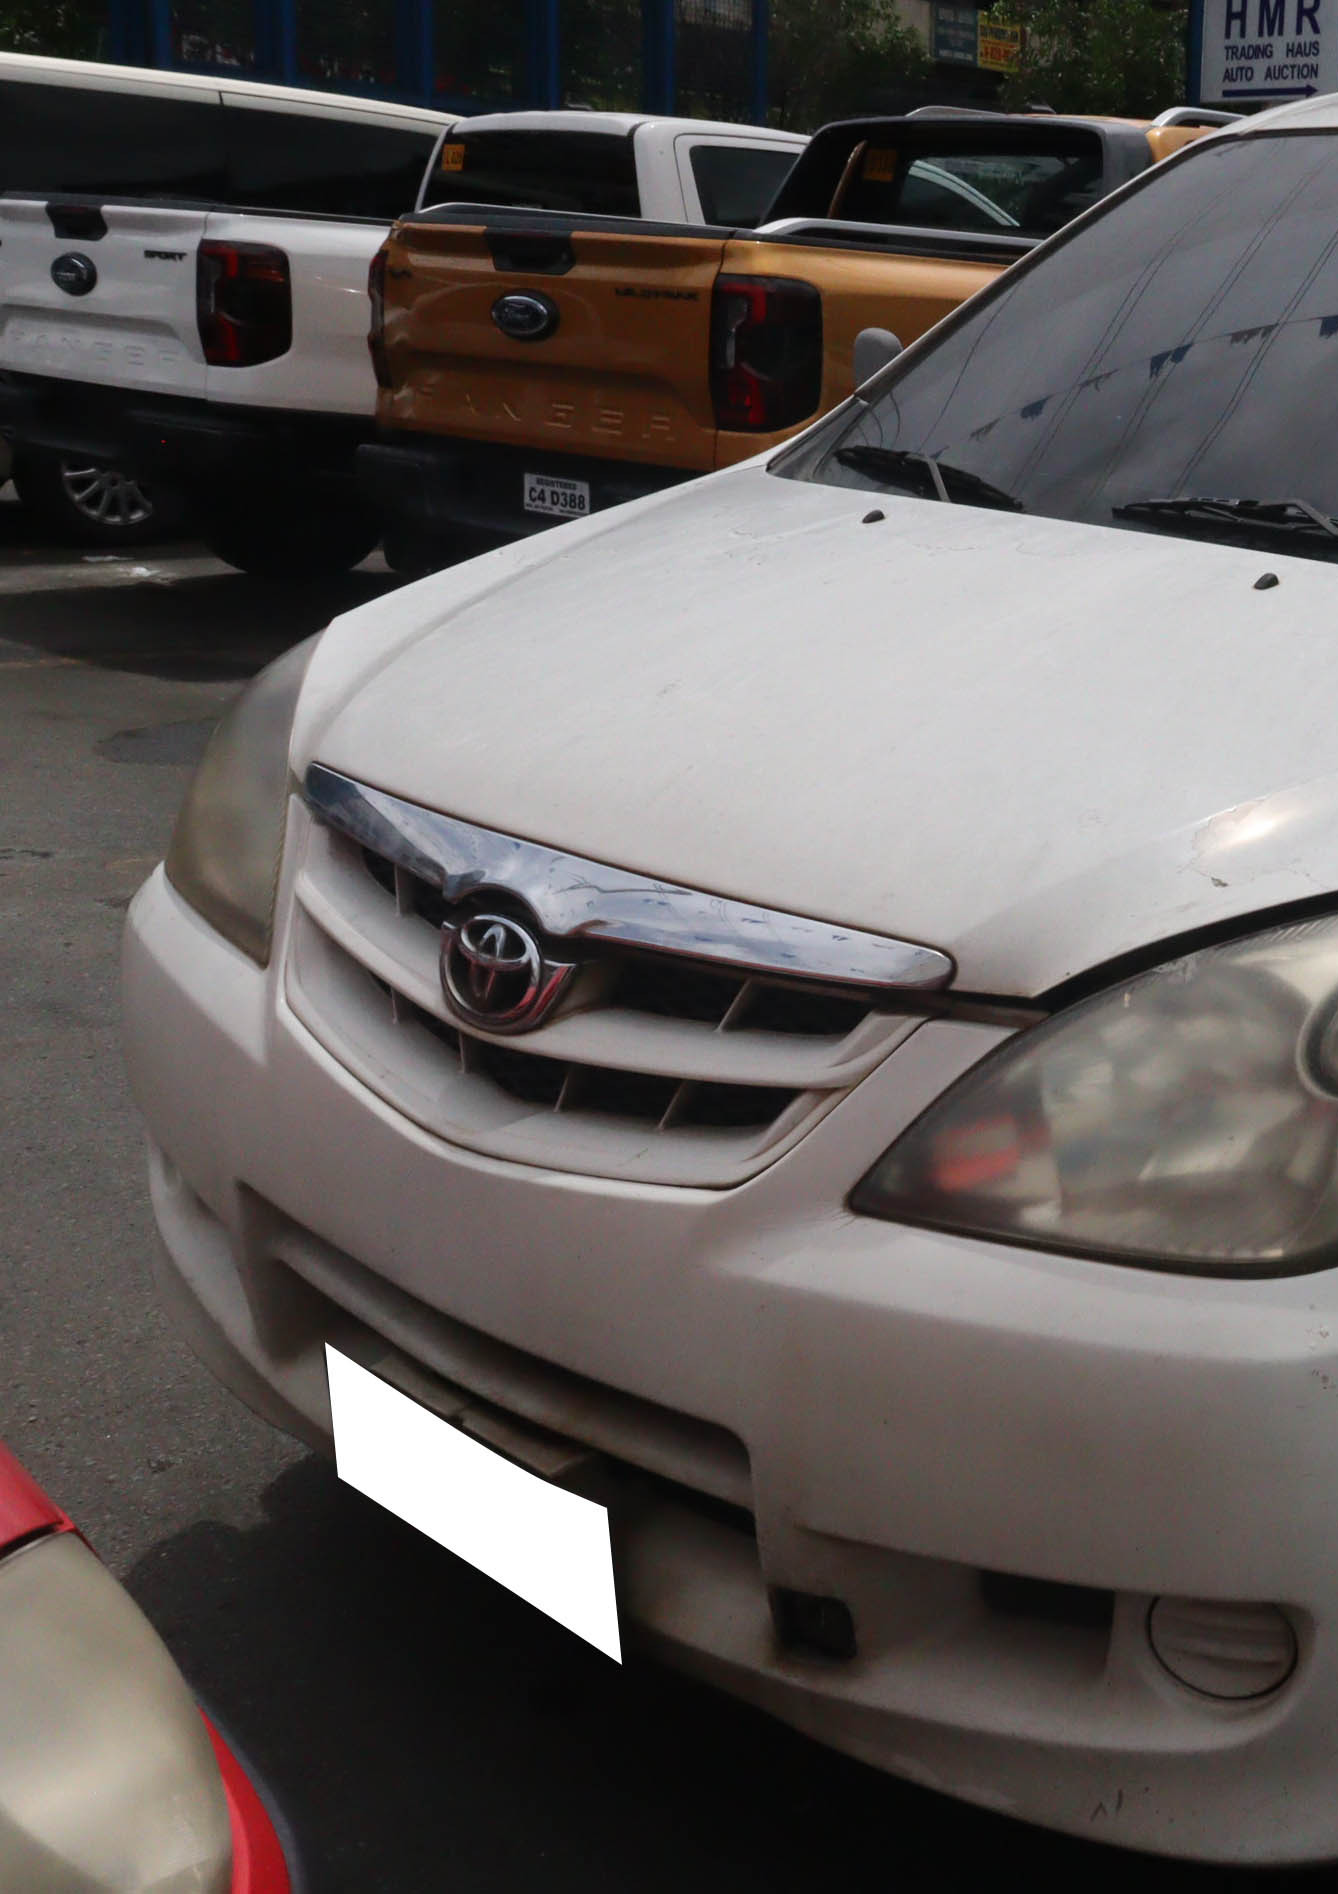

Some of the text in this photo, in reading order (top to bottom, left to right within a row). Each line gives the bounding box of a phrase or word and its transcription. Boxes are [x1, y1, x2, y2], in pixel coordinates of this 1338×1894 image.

[1224, 0, 1321, 39] HMR
[1224, 41, 1320, 61] TRADING HAUS
[1222, 63, 1319, 83] AUTO AUCTION
[529, 487, 546, 504] C4
[551, 490, 586, 511] D388
